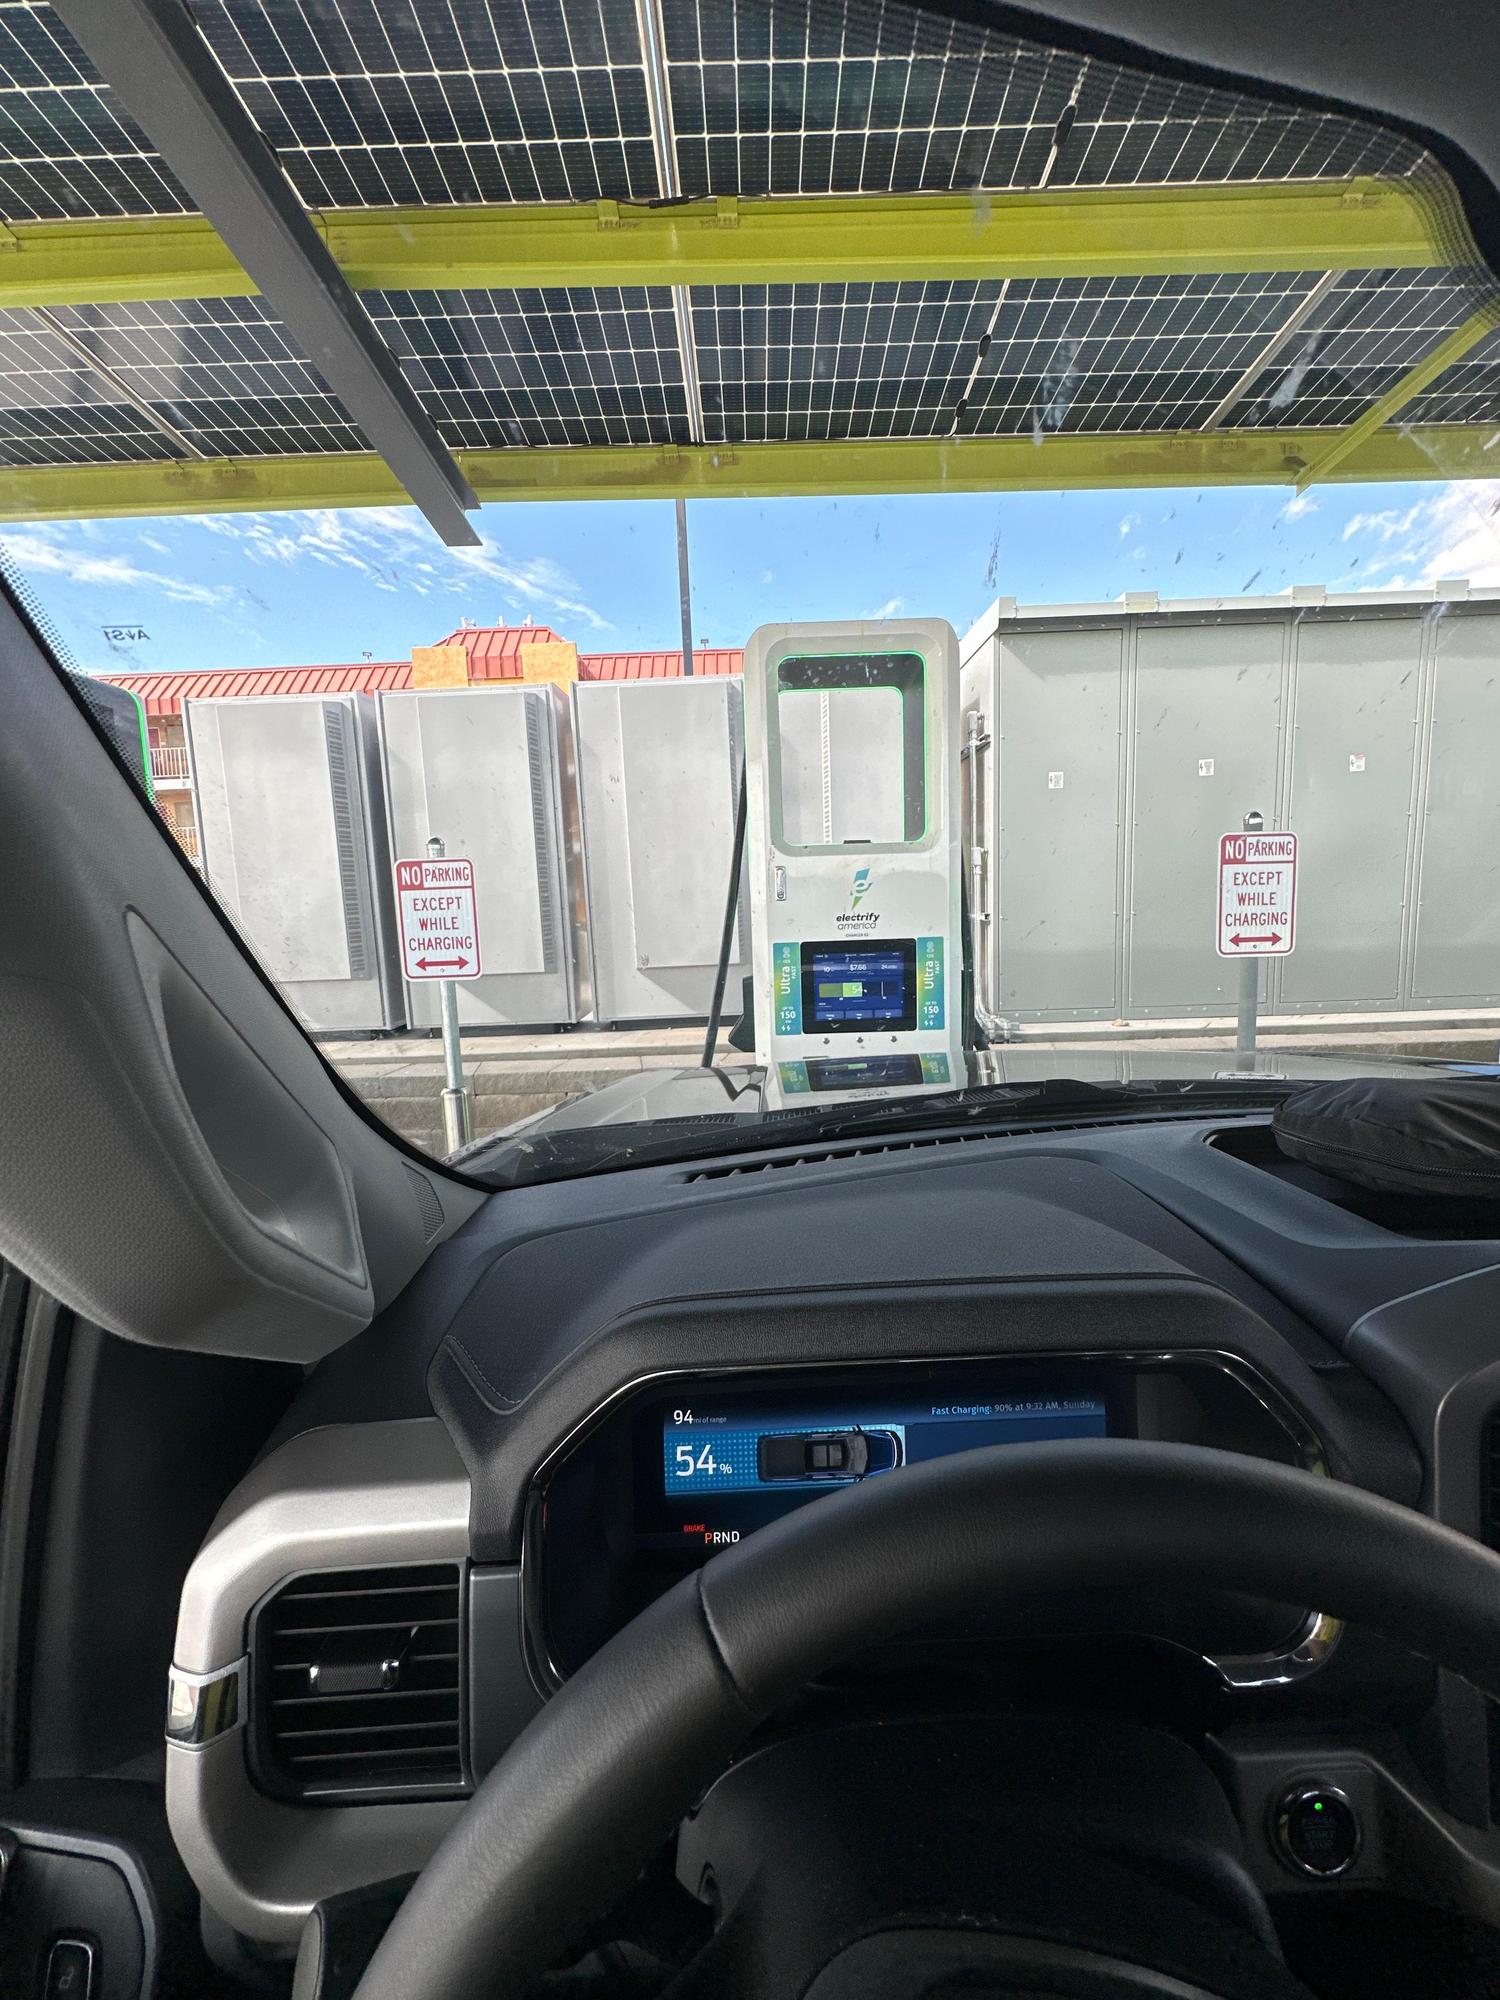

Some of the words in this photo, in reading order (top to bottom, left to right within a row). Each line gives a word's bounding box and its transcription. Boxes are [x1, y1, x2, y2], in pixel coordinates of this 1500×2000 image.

[1225, 840, 1244, 860] NO
[1248, 840, 1293, 856] PARKING
[400, 867, 421, 886] NO
[424, 867, 470, 882] PARKING
[1233, 871, 1282, 886] EXCEPT
[413, 896, 462, 911] EXCEPT
[1237, 892, 1276, 906] WHILE
[418, 917, 459, 931] WHILE
[836, 912, 880, 922] electrify
[1225, 911, 1288, 927] CHARGING
[837, 922, 877, 930] america
[408, 935, 473, 951] CHARGING
[780, 966, 790, 994] Ultra
[923, 961, 934, 989] Ultra
[780, 1011, 796, 1019] 150
[923, 1006, 939, 1014] 150
[931, 1406, 950, 1415] Fast
[951, 1404, 992, 1416] Charging:
[994, 1403, 1013, 1412] 90%
[1014, 1403, 1024, 1412] at
[1026, 1402, 1043, 1410] 9:32
[1063, 1400, 1096, 1411] Sunday
[673, 1409, 694, 1425] 94
[702, 1416, 709, 1424] of
[710, 1416, 727, 1424] range
[675, 1444, 717, 1477] 54
[720, 1463, 733, 1475] %
